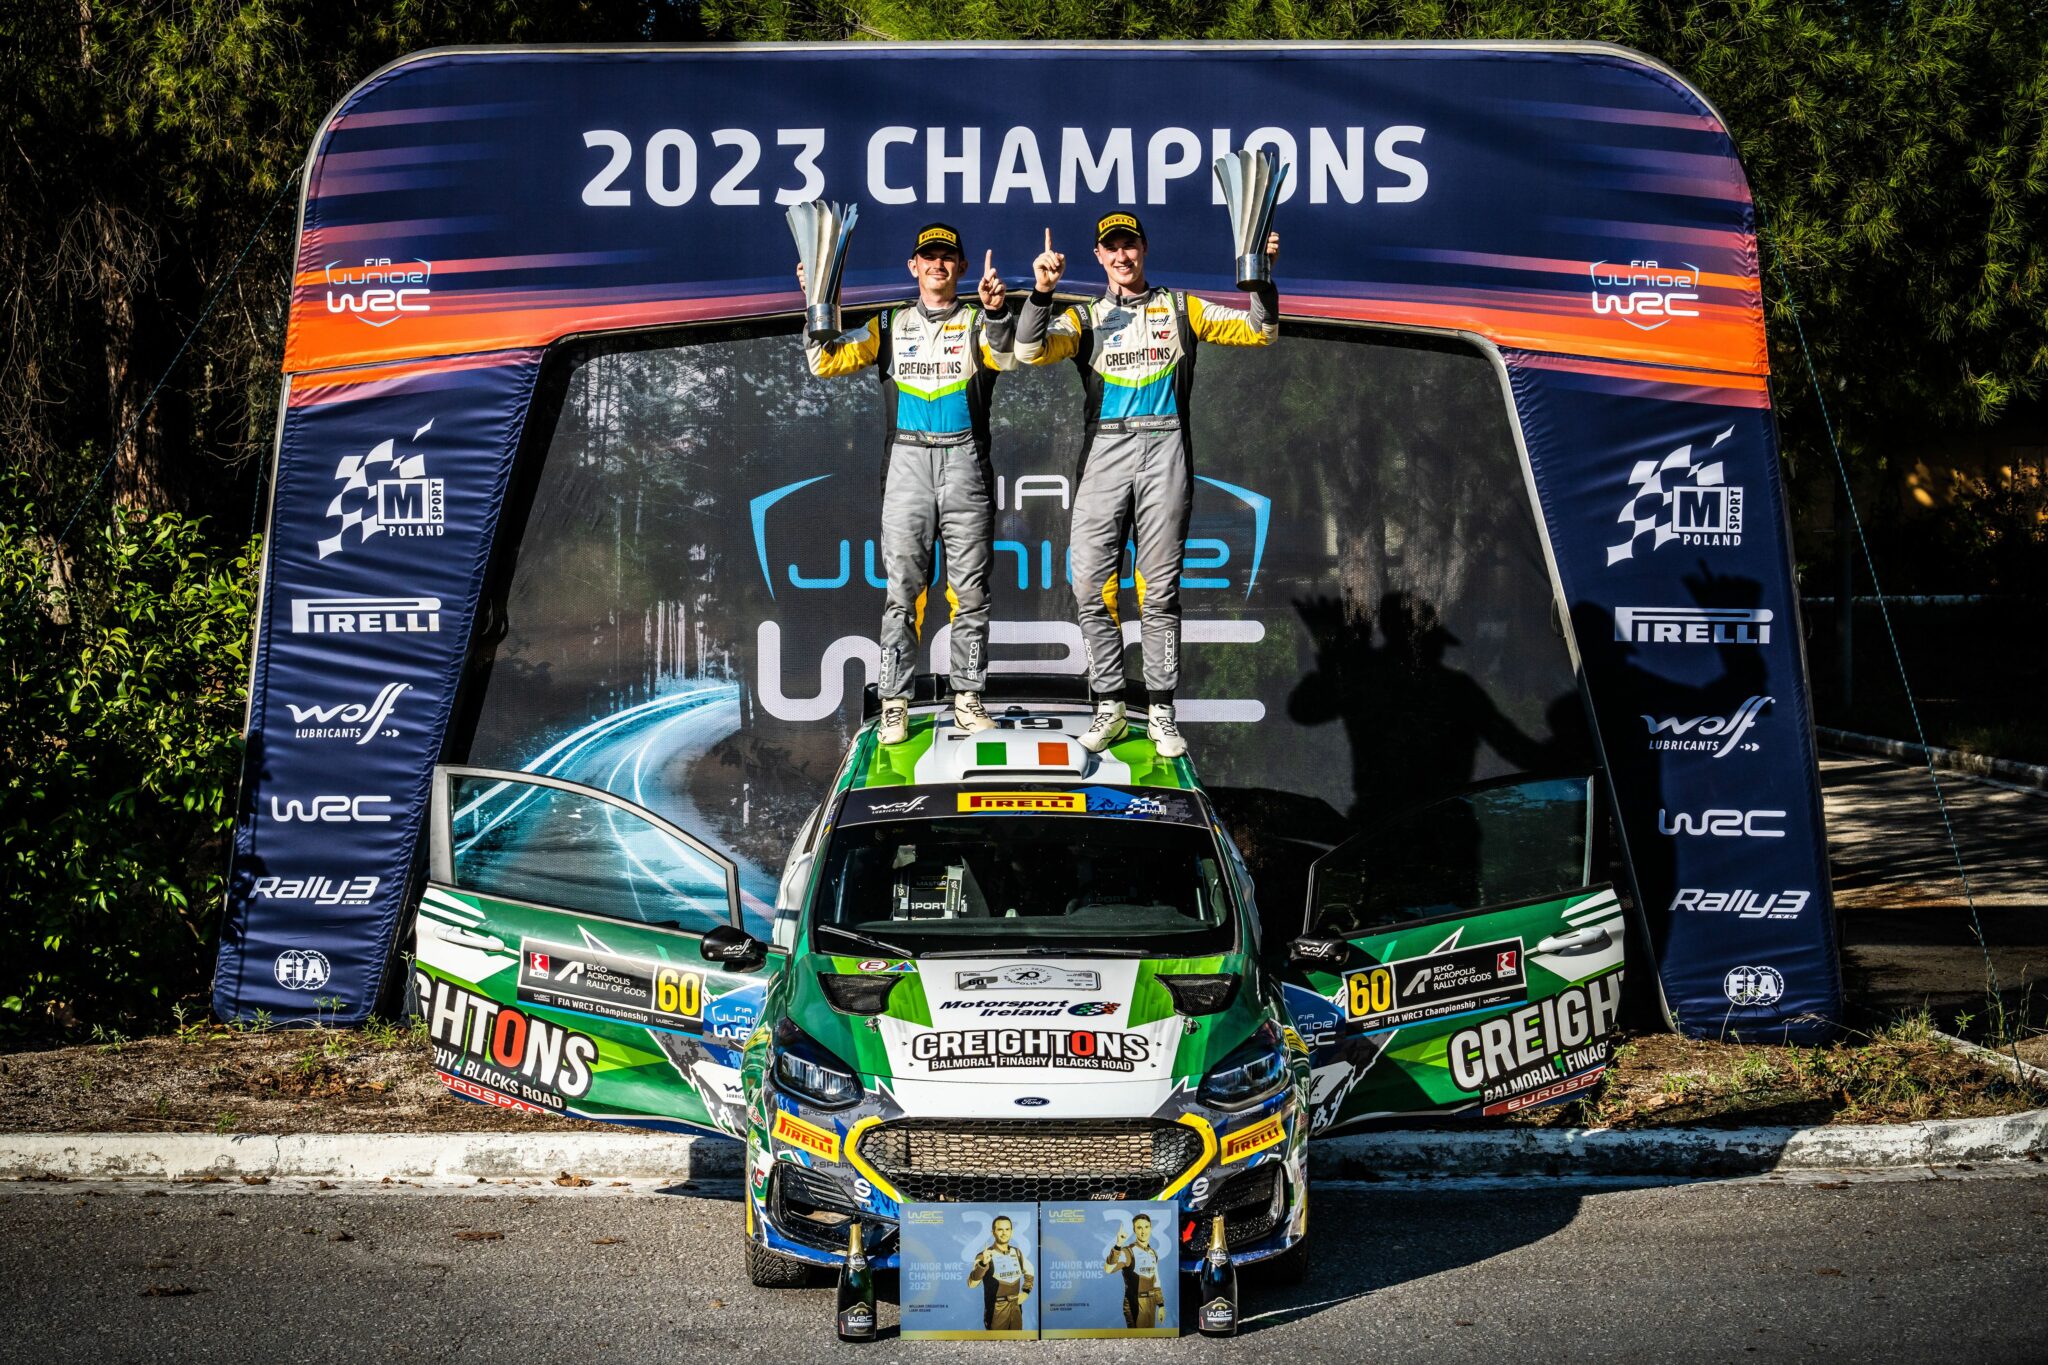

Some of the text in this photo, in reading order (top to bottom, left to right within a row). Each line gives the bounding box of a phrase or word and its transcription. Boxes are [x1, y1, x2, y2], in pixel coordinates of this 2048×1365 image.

[581, 125, 1429, 207] 2023 CHAMPIONS
[364, 258, 392, 267] FIA
[1630, 260, 1659, 269] FIA
[333, 272, 424, 285] JUNIOR
[1598, 274, 1692, 288] JUNIOR
[326, 288, 431, 313] WRC
[1591, 291, 1700, 317] WRC
[1105, 347, 1171, 366] CREIGHTONS
[899, 361, 962, 376] CREIGHTONS
[384, 483, 423, 519] M
[431, 482, 443, 520] SPORT
[1679, 491, 1721, 528] M
[1728, 490, 1741, 530] SPORT
[388, 525, 445, 537] POLAND
[1683, 534, 1742, 546] POLAND
[291, 597, 442, 633] PIRELLI
[1615, 607, 1774, 644] PIRELLI
[1164, 630, 1175, 672] sparco
[967, 641, 980, 680] sparco
[295, 728, 362, 738] LUBRICANTS
[1649, 741, 1719, 751] LUBRICANTS
[271, 795, 391, 822] WRC
[970, 795, 1074, 808] PIRELLI
[1658, 808, 1787, 837] WRC
[248, 876, 380, 905] Rally3
[1668, 888, 1811, 919] Rally3
[587, 964, 607, 973] EKO
[1433, 964, 1454, 973] EKO
[1434, 967, 1476, 982] ACROPOLIS
[587, 971, 631, 986] ACROPOLIS
[1433, 972, 1492, 991] RALLY OF GODS
[586, 980, 647, 998] RALLY OF GODS
[657, 968, 700, 1016] 60
[1350, 969, 1391, 1017] 60
[557, 997, 648, 1023] FIA WRC3 Championship
[939, 1000, 1069, 1010] Motorsport
[980, 1008, 1063, 1017] Ireland
[1387, 1000, 1476, 1025] FIA WRC3 Championship
[1451, 970, 1624, 1089] CREIGH
[914, 1029, 1148, 1061] CREIGHTONS
[931, 1057, 1132, 1071] BALMORAL FINAGHY BLACKS ROAD
[1484, 1040, 1609, 1103] BALMORAL FINAG
[464, 1060, 518, 1094] BLACKS
[523, 1085, 563, 1109] ROAD
[778, 1116, 833, 1155] PIRELLI
[1226, 1120, 1280, 1157] PIRELLI
[908, 1210, 944, 1219] WRC
[1049, 1209, 1085, 1218] WRC
[909, 1263, 963, 1271] JUNIOR WRC
[1050, 1261, 1104, 1270] JUNIOR WRC
[909, 1272, 962, 1281] CHAMPIONS
[1050, 1271, 1103, 1279] CHAMPIONS
[909, 1282, 931, 1290] 2023
[1050, 1281, 1072, 1289] 2023
[1206, 1309, 1233, 1317] WRC
